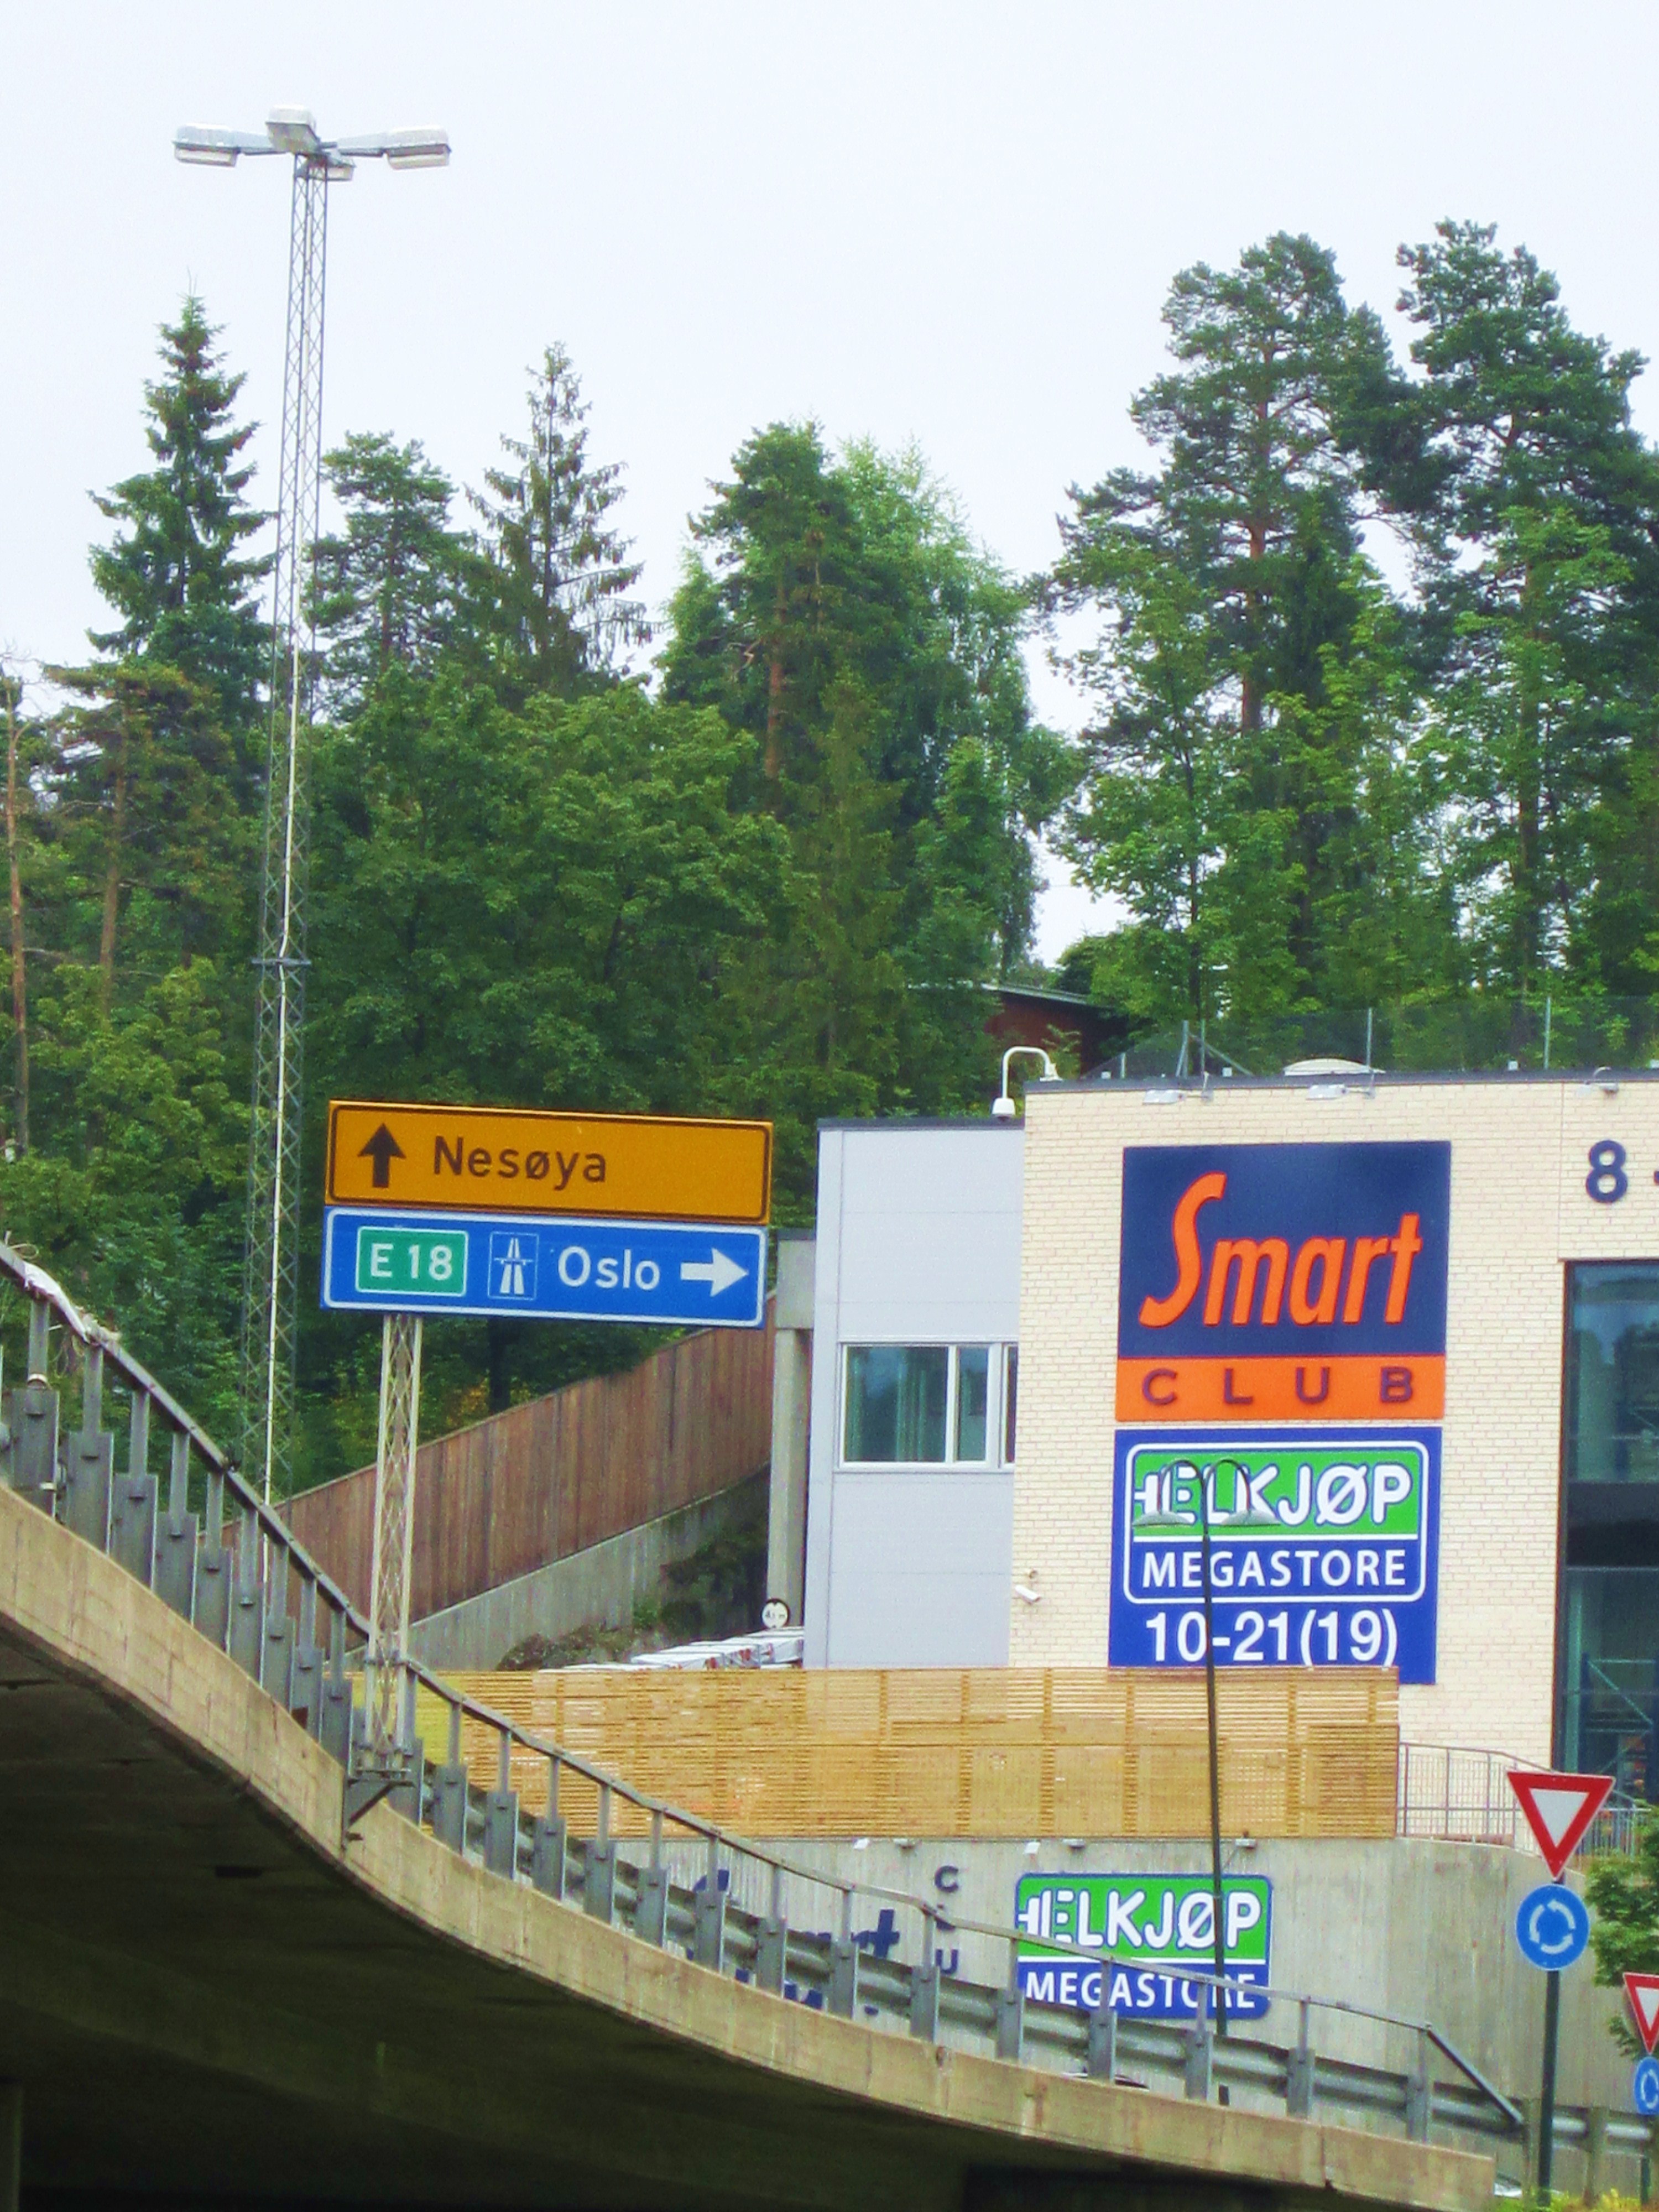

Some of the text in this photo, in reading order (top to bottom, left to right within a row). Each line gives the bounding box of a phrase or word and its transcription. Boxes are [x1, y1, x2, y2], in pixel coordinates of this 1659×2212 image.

[433, 1135, 607, 1191] Nesøya
[370, 1243, 453, 1281] E 18
[557, 1246, 661, 1291] Oslo
[1138, 1171, 1423, 1328] Smart
[1141, 1366, 1413, 1405] CLUB
[1134, 1463, 1412, 1526] ELKJØP
[1142, 1550, 1406, 1588] MEGASTORE
[1018, 1889, 1261, 1949] ELKJØP
